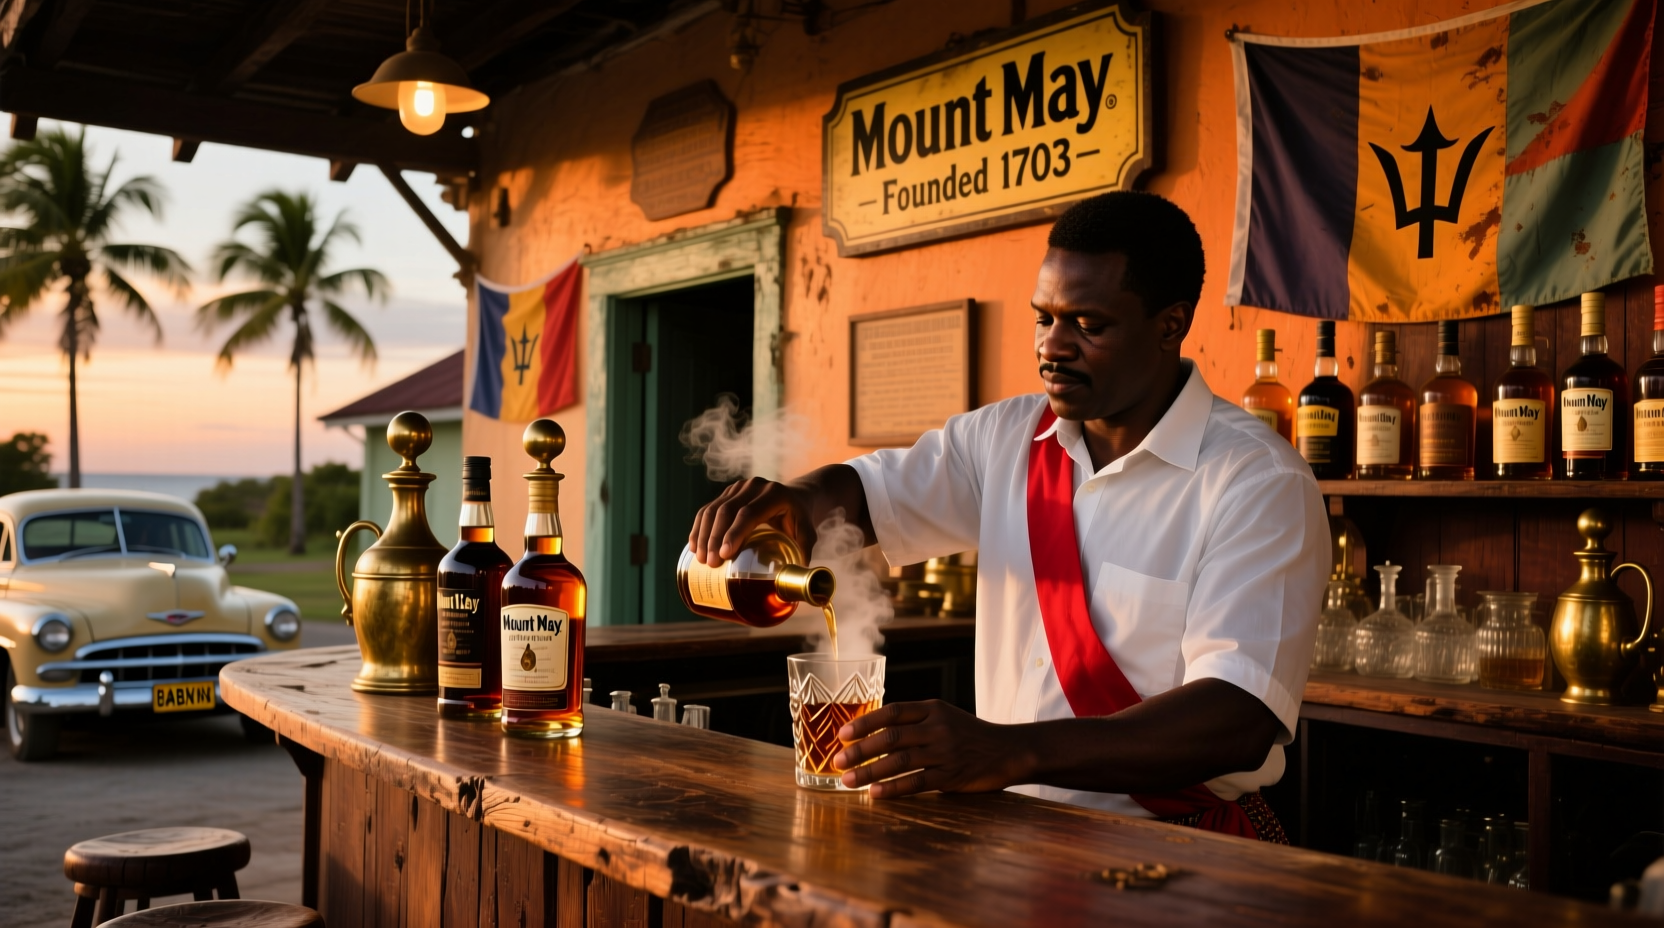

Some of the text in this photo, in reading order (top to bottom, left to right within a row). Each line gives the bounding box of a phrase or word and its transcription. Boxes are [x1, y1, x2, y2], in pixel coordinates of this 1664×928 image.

[850, 50, 1114, 177] Mount May
[882, 137, 1071, 215] Founded 1703
[537, 614, 563, 637] May
